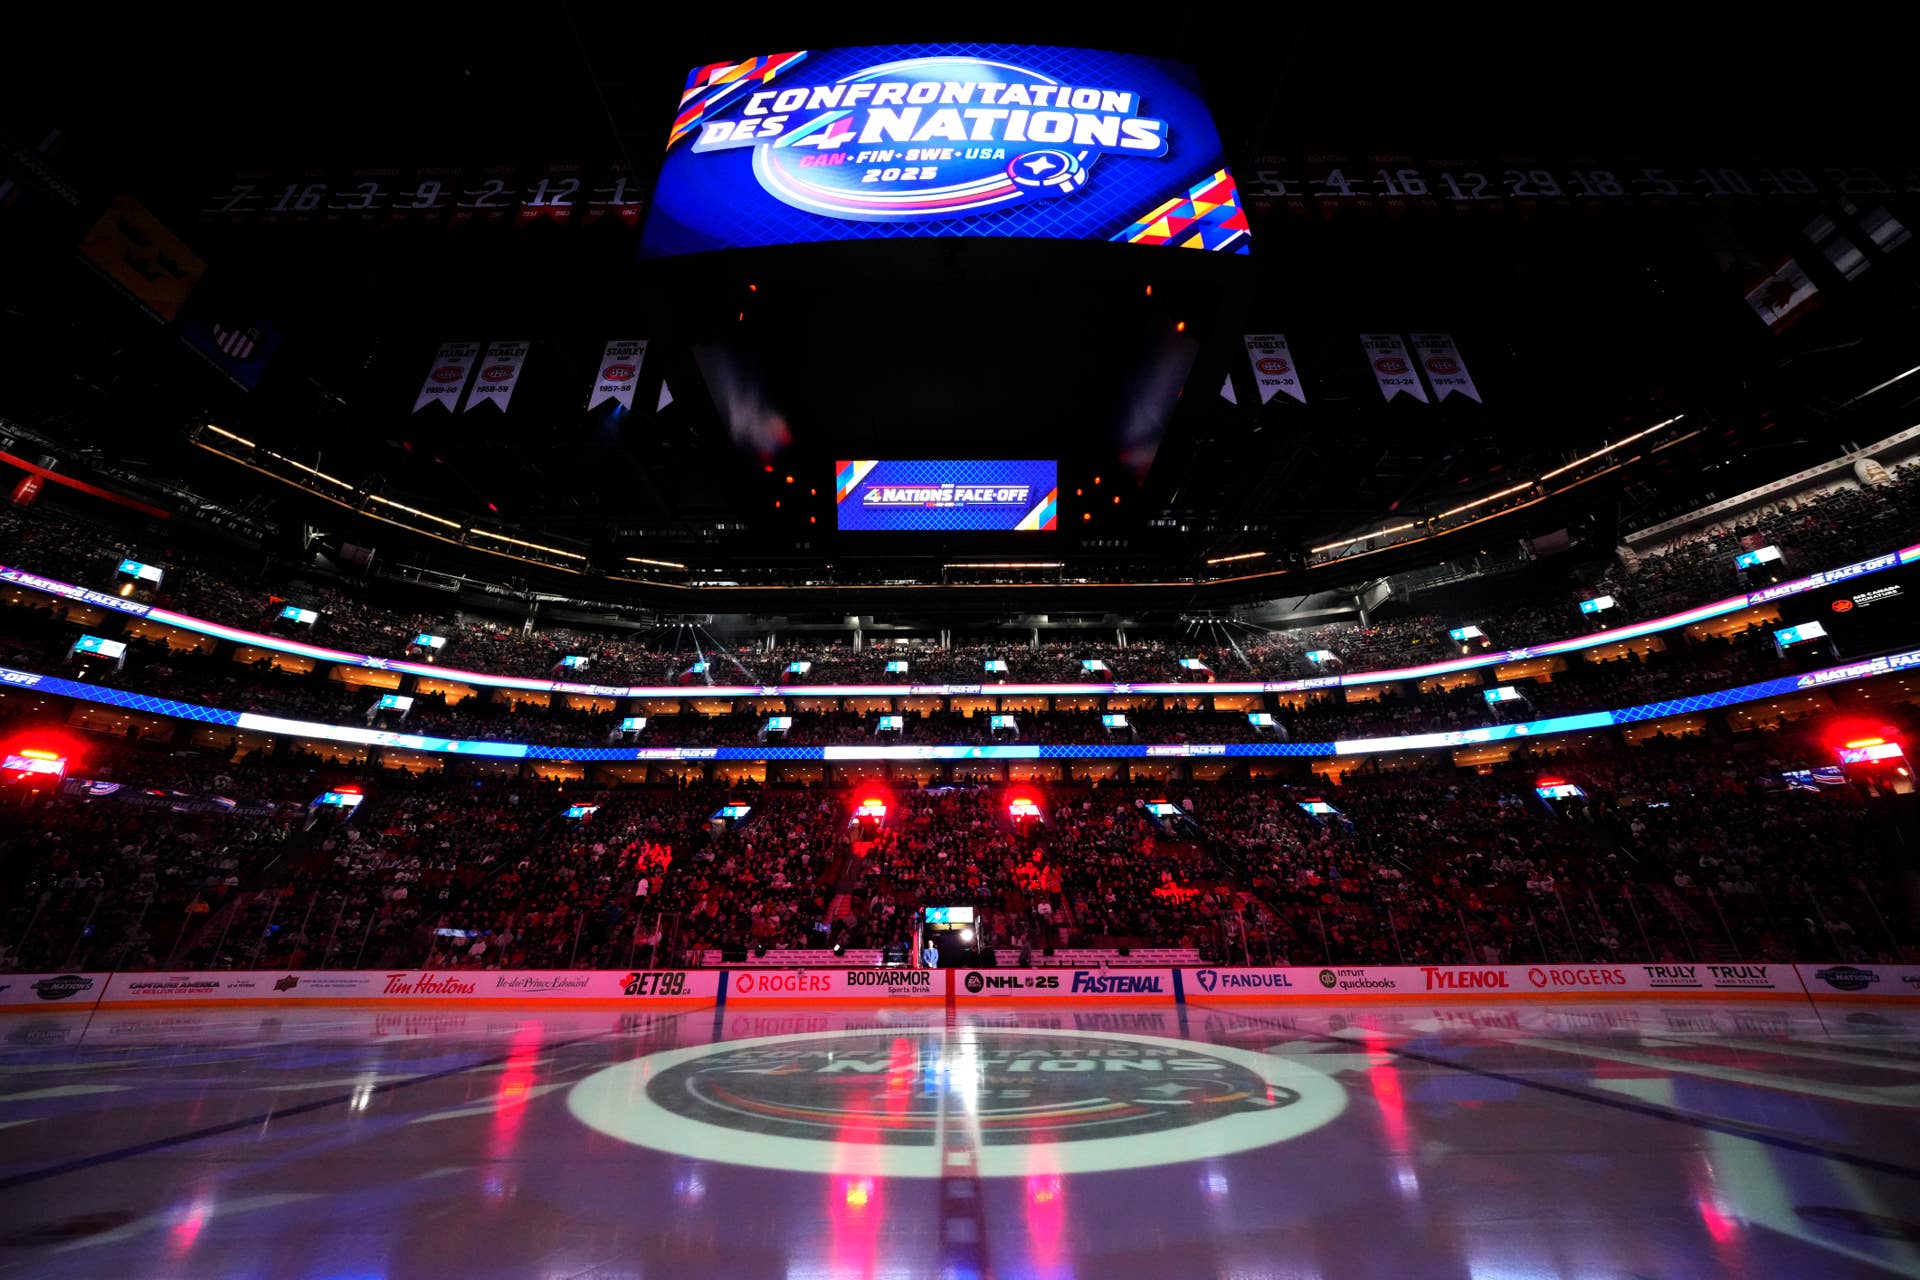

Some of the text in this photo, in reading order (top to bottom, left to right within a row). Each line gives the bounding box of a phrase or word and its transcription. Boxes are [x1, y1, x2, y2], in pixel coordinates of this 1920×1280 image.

[743, 81, 1133, 117] CONFRONTATION
[703, 107, 1162, 152] DES 4 NATIONS
[800, 147, 1006, 166] CAN FIN SWE USA
[862, 167, 938, 183] 2025
[1257, 170, 1286, 195] 5
[1325, 168, 1352, 195] 4
[1378, 169, 1429, 195] 16
[1441, 172, 1489, 200] 12
[277, 183, 328, 211] 16
[346, 181, 379, 209] 3
[411, 180, 442, 209] 9
[475, 178, 505, 207] 2
[527, 177, 581, 206] 12
[607, 177, 629, 206] 1
[606, 347, 645, 356] STANLEY
[1247, 341, 1286, 350] STANLEY
[863, 488, 882, 502] 4
[882, 488, 953, 502] NATIONS
[18, 574, 86, 598] NATIONS
[1763, 574, 1826, 600] NATIONS
[1854, 589, 1899, 603] SIGNATURE
[1866, 584, 1901, 598] CANADA
[1798, 676, 1815, 687] 4
[1814, 660, 1889, 683] NATIONS
[847, 971, 931, 986] BODYARMOR
[985, 976, 1060, 989] NHL 25
[1071, 971, 1164, 993] FASTENAL
[1221, 974, 1293, 988] FANDUEL
[1420, 967, 1510, 990] TYLENOL
[1549, 969, 1627, 986] ROGERS
[1643, 966, 1696, 978] TRULY
[1706, 966, 1767, 979] TRULY
[383, 973, 413, 995] Tim
[412, 973, 476, 995] Hortons
[758, 975, 831, 992] ROGERS
[888, 986, 911, 994] Sports
[1339, 978, 1396, 991] quickbooks
